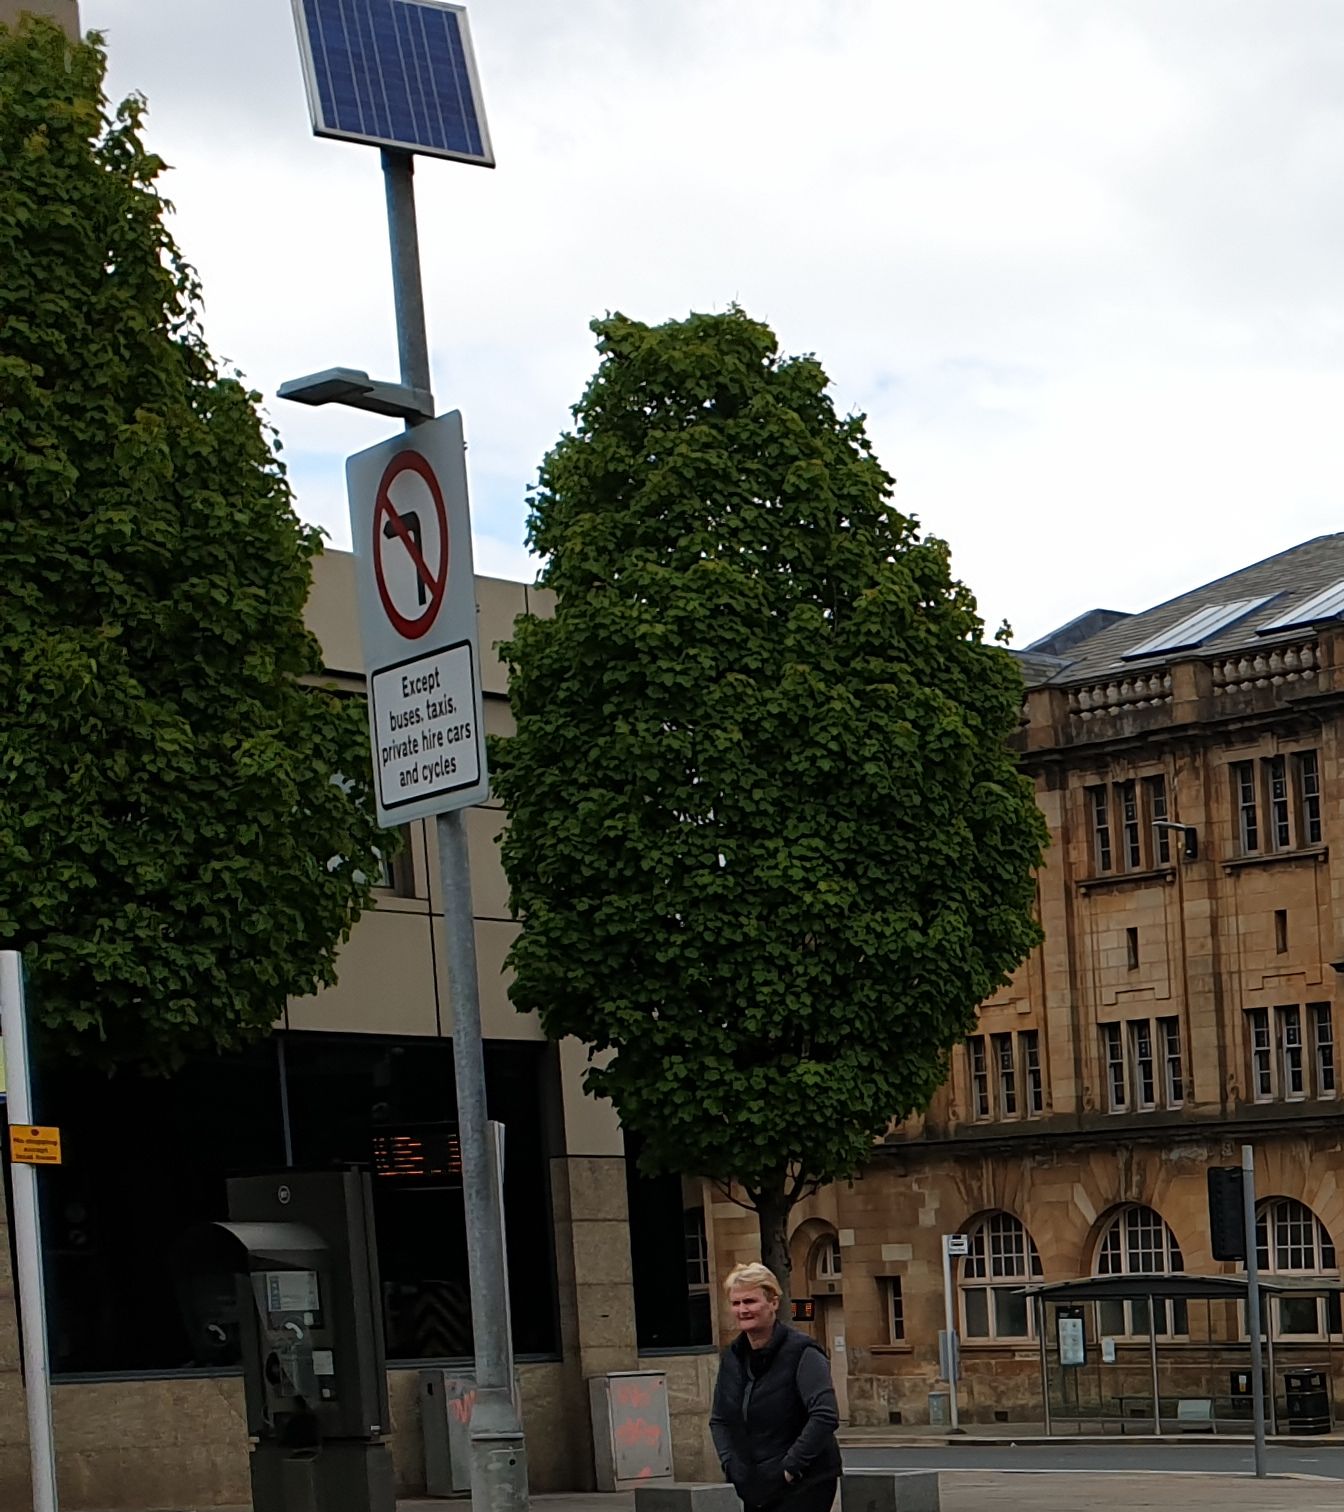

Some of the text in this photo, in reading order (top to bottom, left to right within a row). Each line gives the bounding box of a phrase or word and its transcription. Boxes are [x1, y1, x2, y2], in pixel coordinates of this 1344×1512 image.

[402, 666, 441, 698] Except
[382, 722, 471, 767] private hire cars
[400, 755, 457, 787] and cycles
